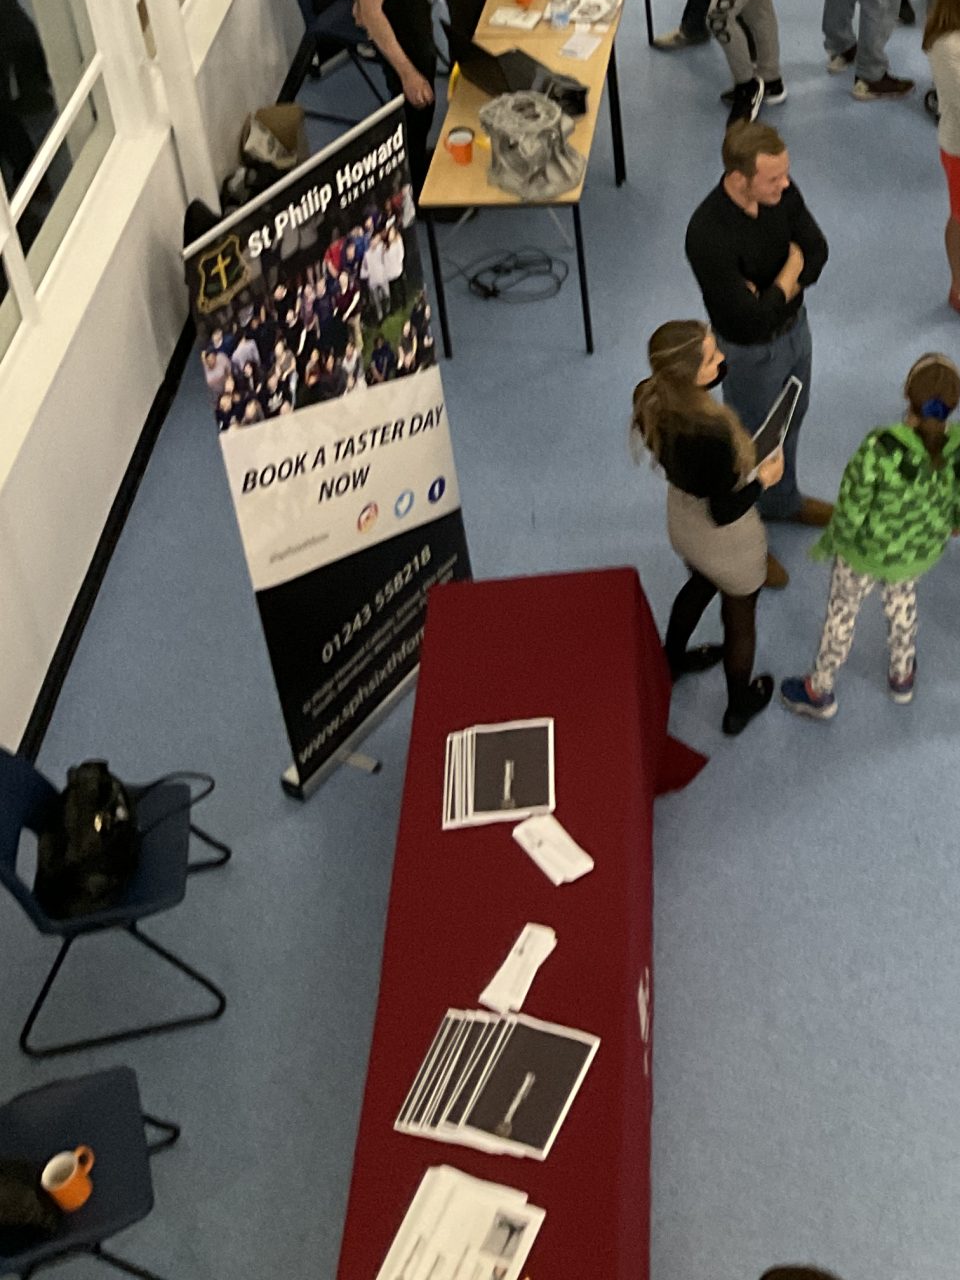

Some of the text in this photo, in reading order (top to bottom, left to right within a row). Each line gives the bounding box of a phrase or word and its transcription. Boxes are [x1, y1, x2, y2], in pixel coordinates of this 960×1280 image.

[248, 123, 403, 258] St Philip Howard
[340, 148, 406, 209] SIXTH FORM
[241, 403, 444, 495] BOOK A TASTER DAY
[318, 464, 371, 504] NOW
[322, 603, 372, 664] 01243
